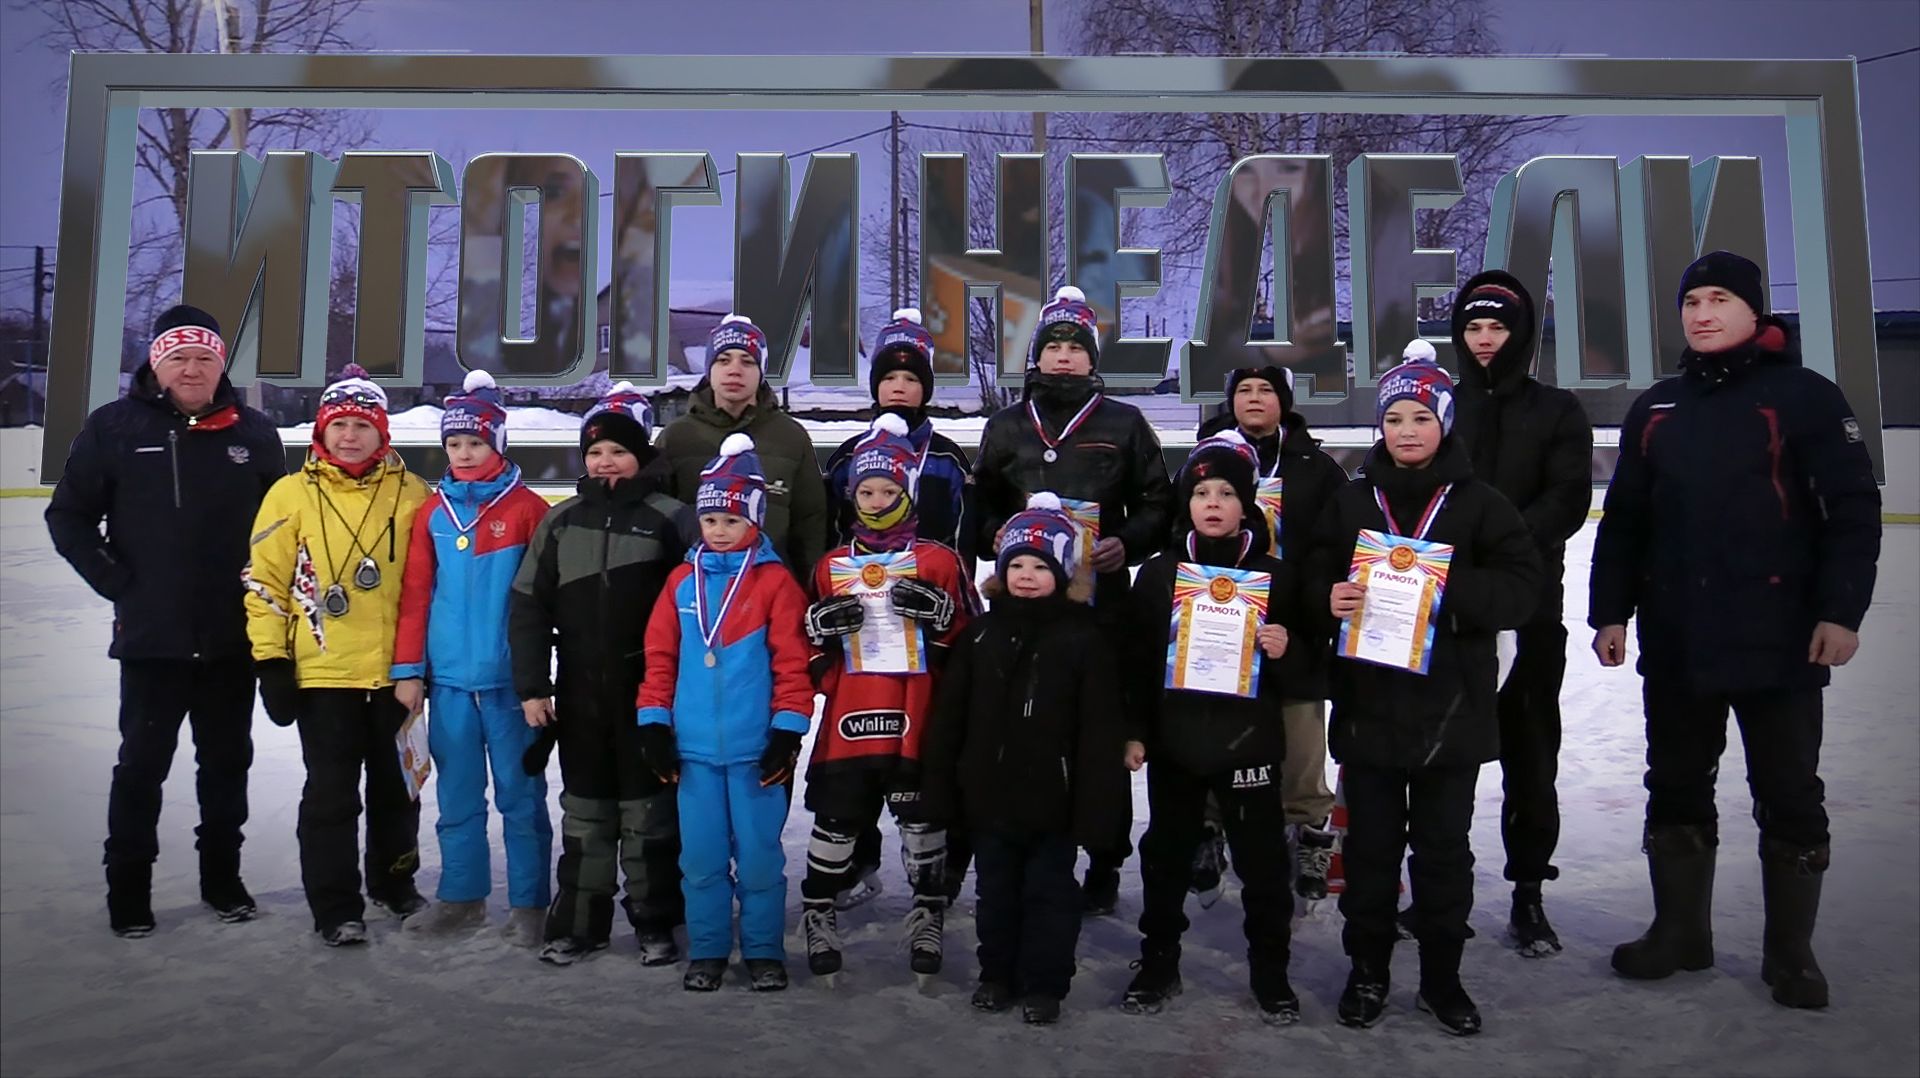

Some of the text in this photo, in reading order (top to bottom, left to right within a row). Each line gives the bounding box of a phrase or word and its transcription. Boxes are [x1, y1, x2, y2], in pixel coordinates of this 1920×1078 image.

[1373, 571, 1419, 586] ГРАМОТА
[857, 590, 892, 600] РАМОТ
[1196, 603, 1241, 617] ГРАМОТА
